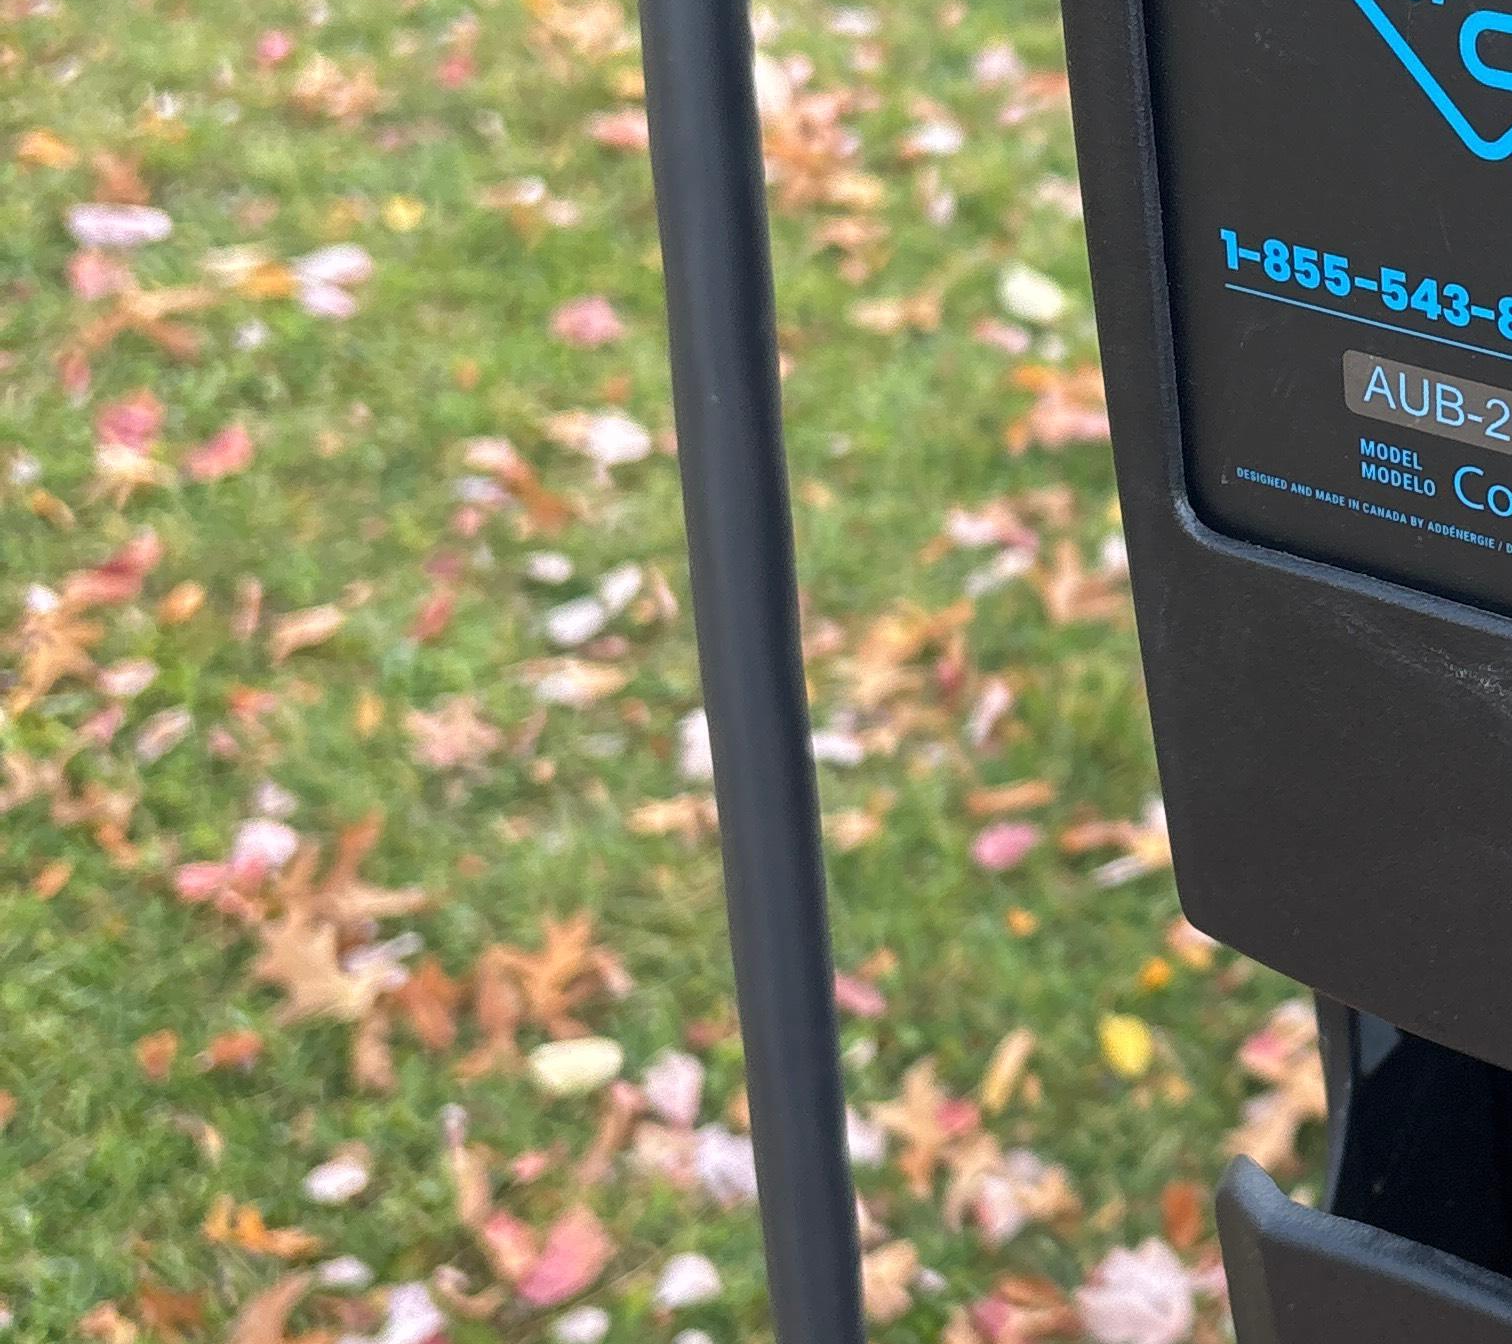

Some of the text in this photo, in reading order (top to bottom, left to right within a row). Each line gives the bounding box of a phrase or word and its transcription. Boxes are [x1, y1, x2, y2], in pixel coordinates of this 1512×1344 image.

[1360, 438, 1423, 471] MODEL
[1236, 467, 1288, 490] DESIGNED
[1290, 482, 1313, 497] AND
[1315, 488, 1345, 506] MADE
[1348, 499, 1360, 511] IN
[1362, 503, 1408, 524] CANADA
[1409, 515, 1424, 528] BY
[1361, 460, 1436, 498] MODELO
